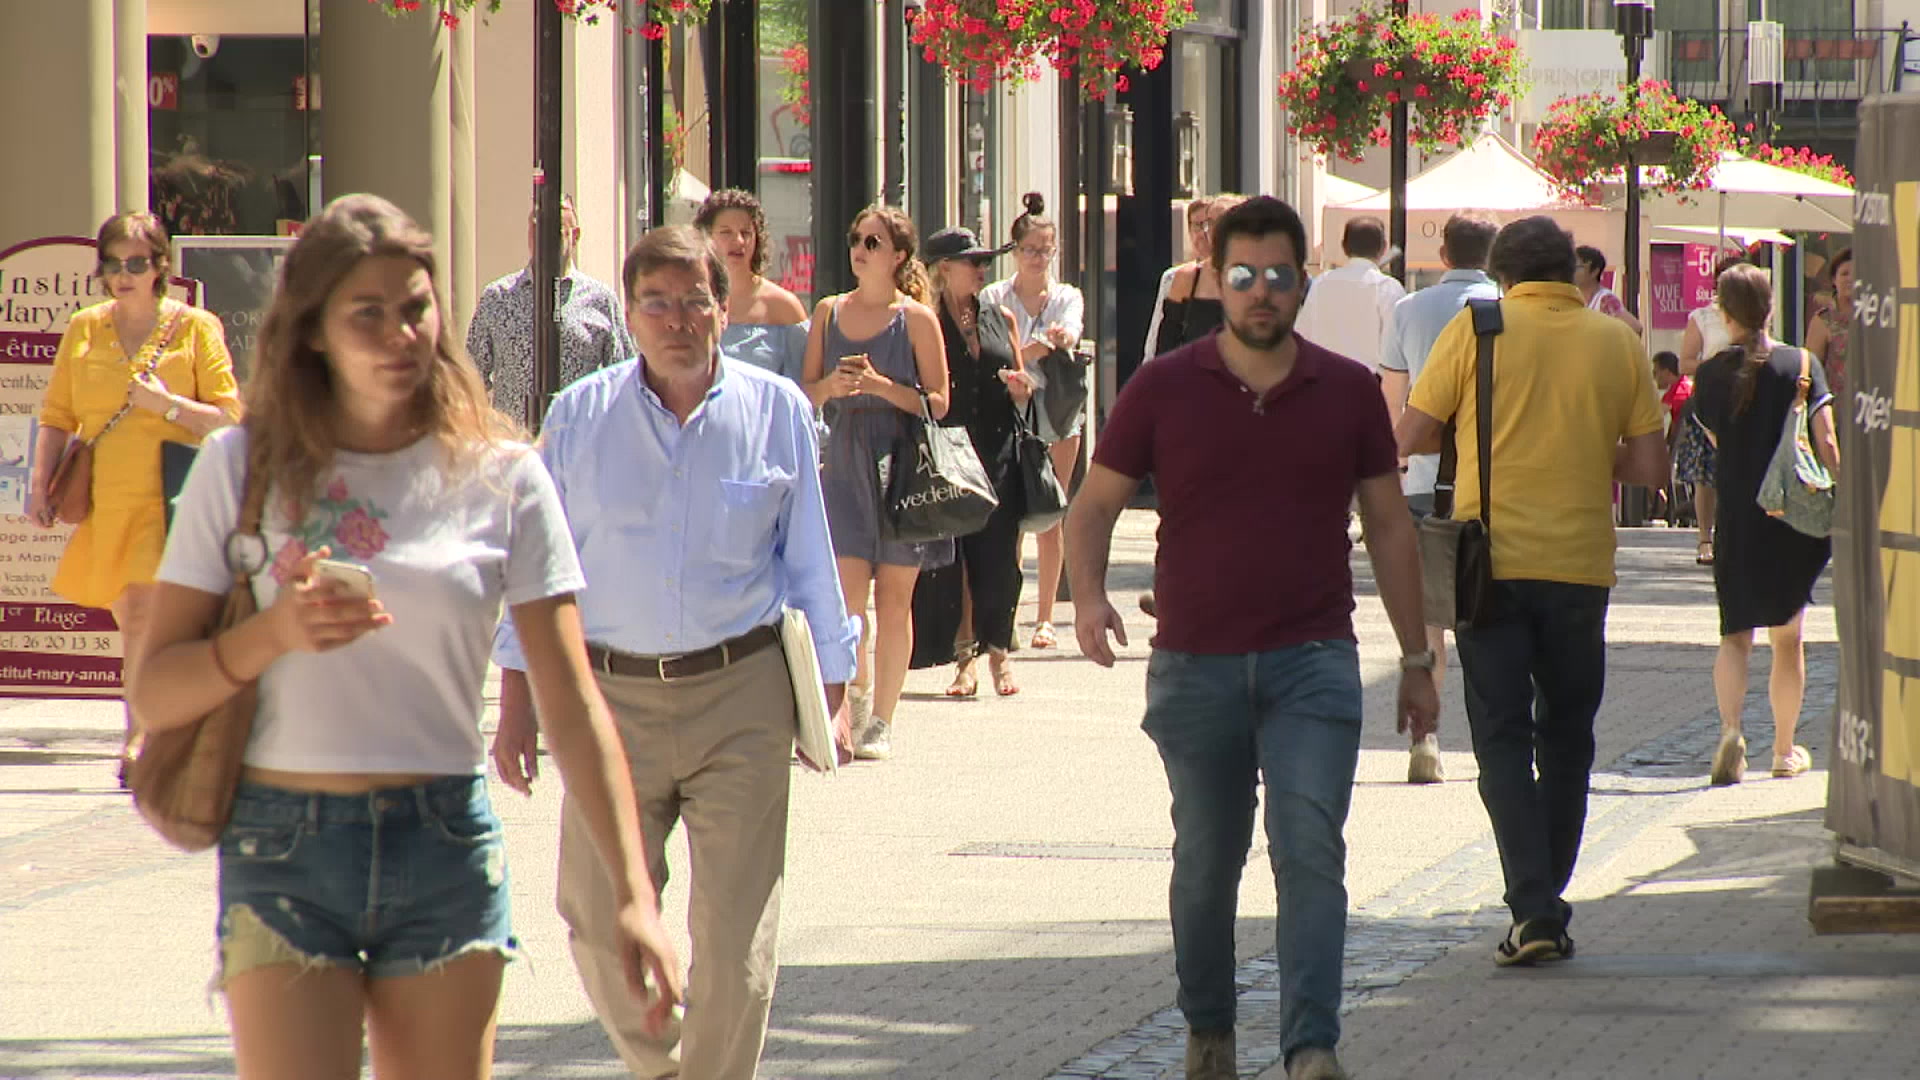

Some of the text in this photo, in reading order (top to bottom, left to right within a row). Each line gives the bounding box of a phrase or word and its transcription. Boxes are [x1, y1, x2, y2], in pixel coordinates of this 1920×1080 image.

[23, 635, 39, 649] 26
[45, 636, 65, 650] 20
[94, 637, 110, 650] 38
